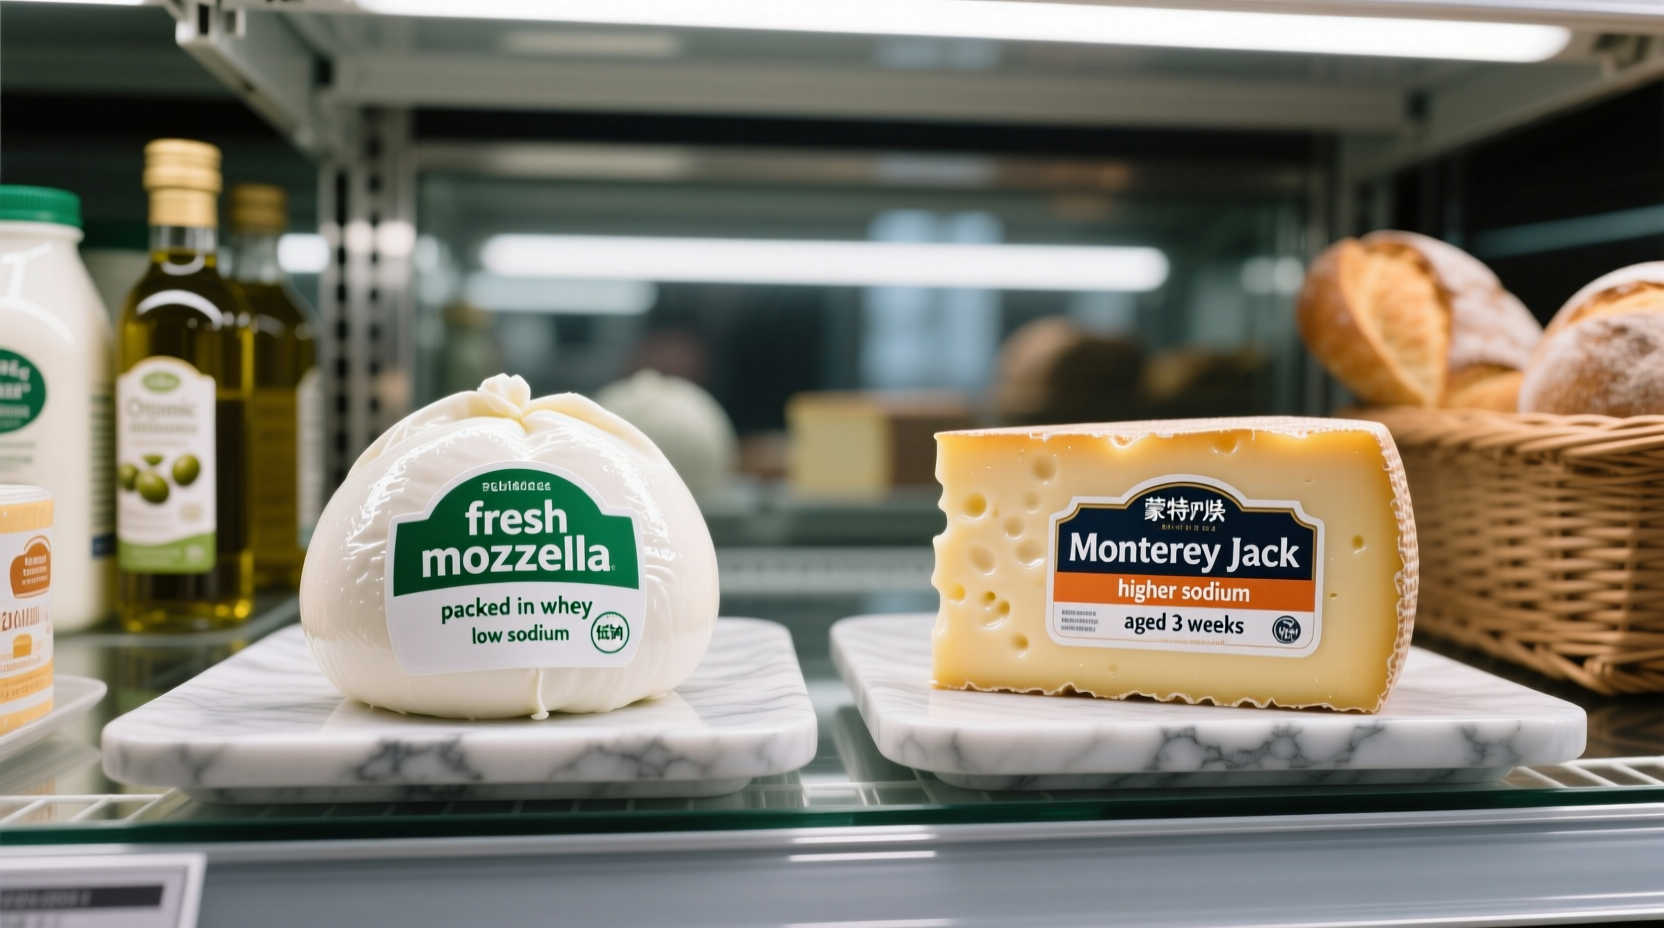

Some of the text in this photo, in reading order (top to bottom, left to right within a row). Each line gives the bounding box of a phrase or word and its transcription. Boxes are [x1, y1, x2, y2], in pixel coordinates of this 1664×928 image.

[465, 499, 567, 535] fresh
[422, 534, 611, 577] mozzella
[1069, 532, 1300, 573] Monterey Jack
[1118, 578, 1250, 603] higher sodium
[441, 595, 593, 624] packed in whey
[1124, 612, 1244, 634] aged 3 weeks
[472, 624, 569, 644] low sodium
